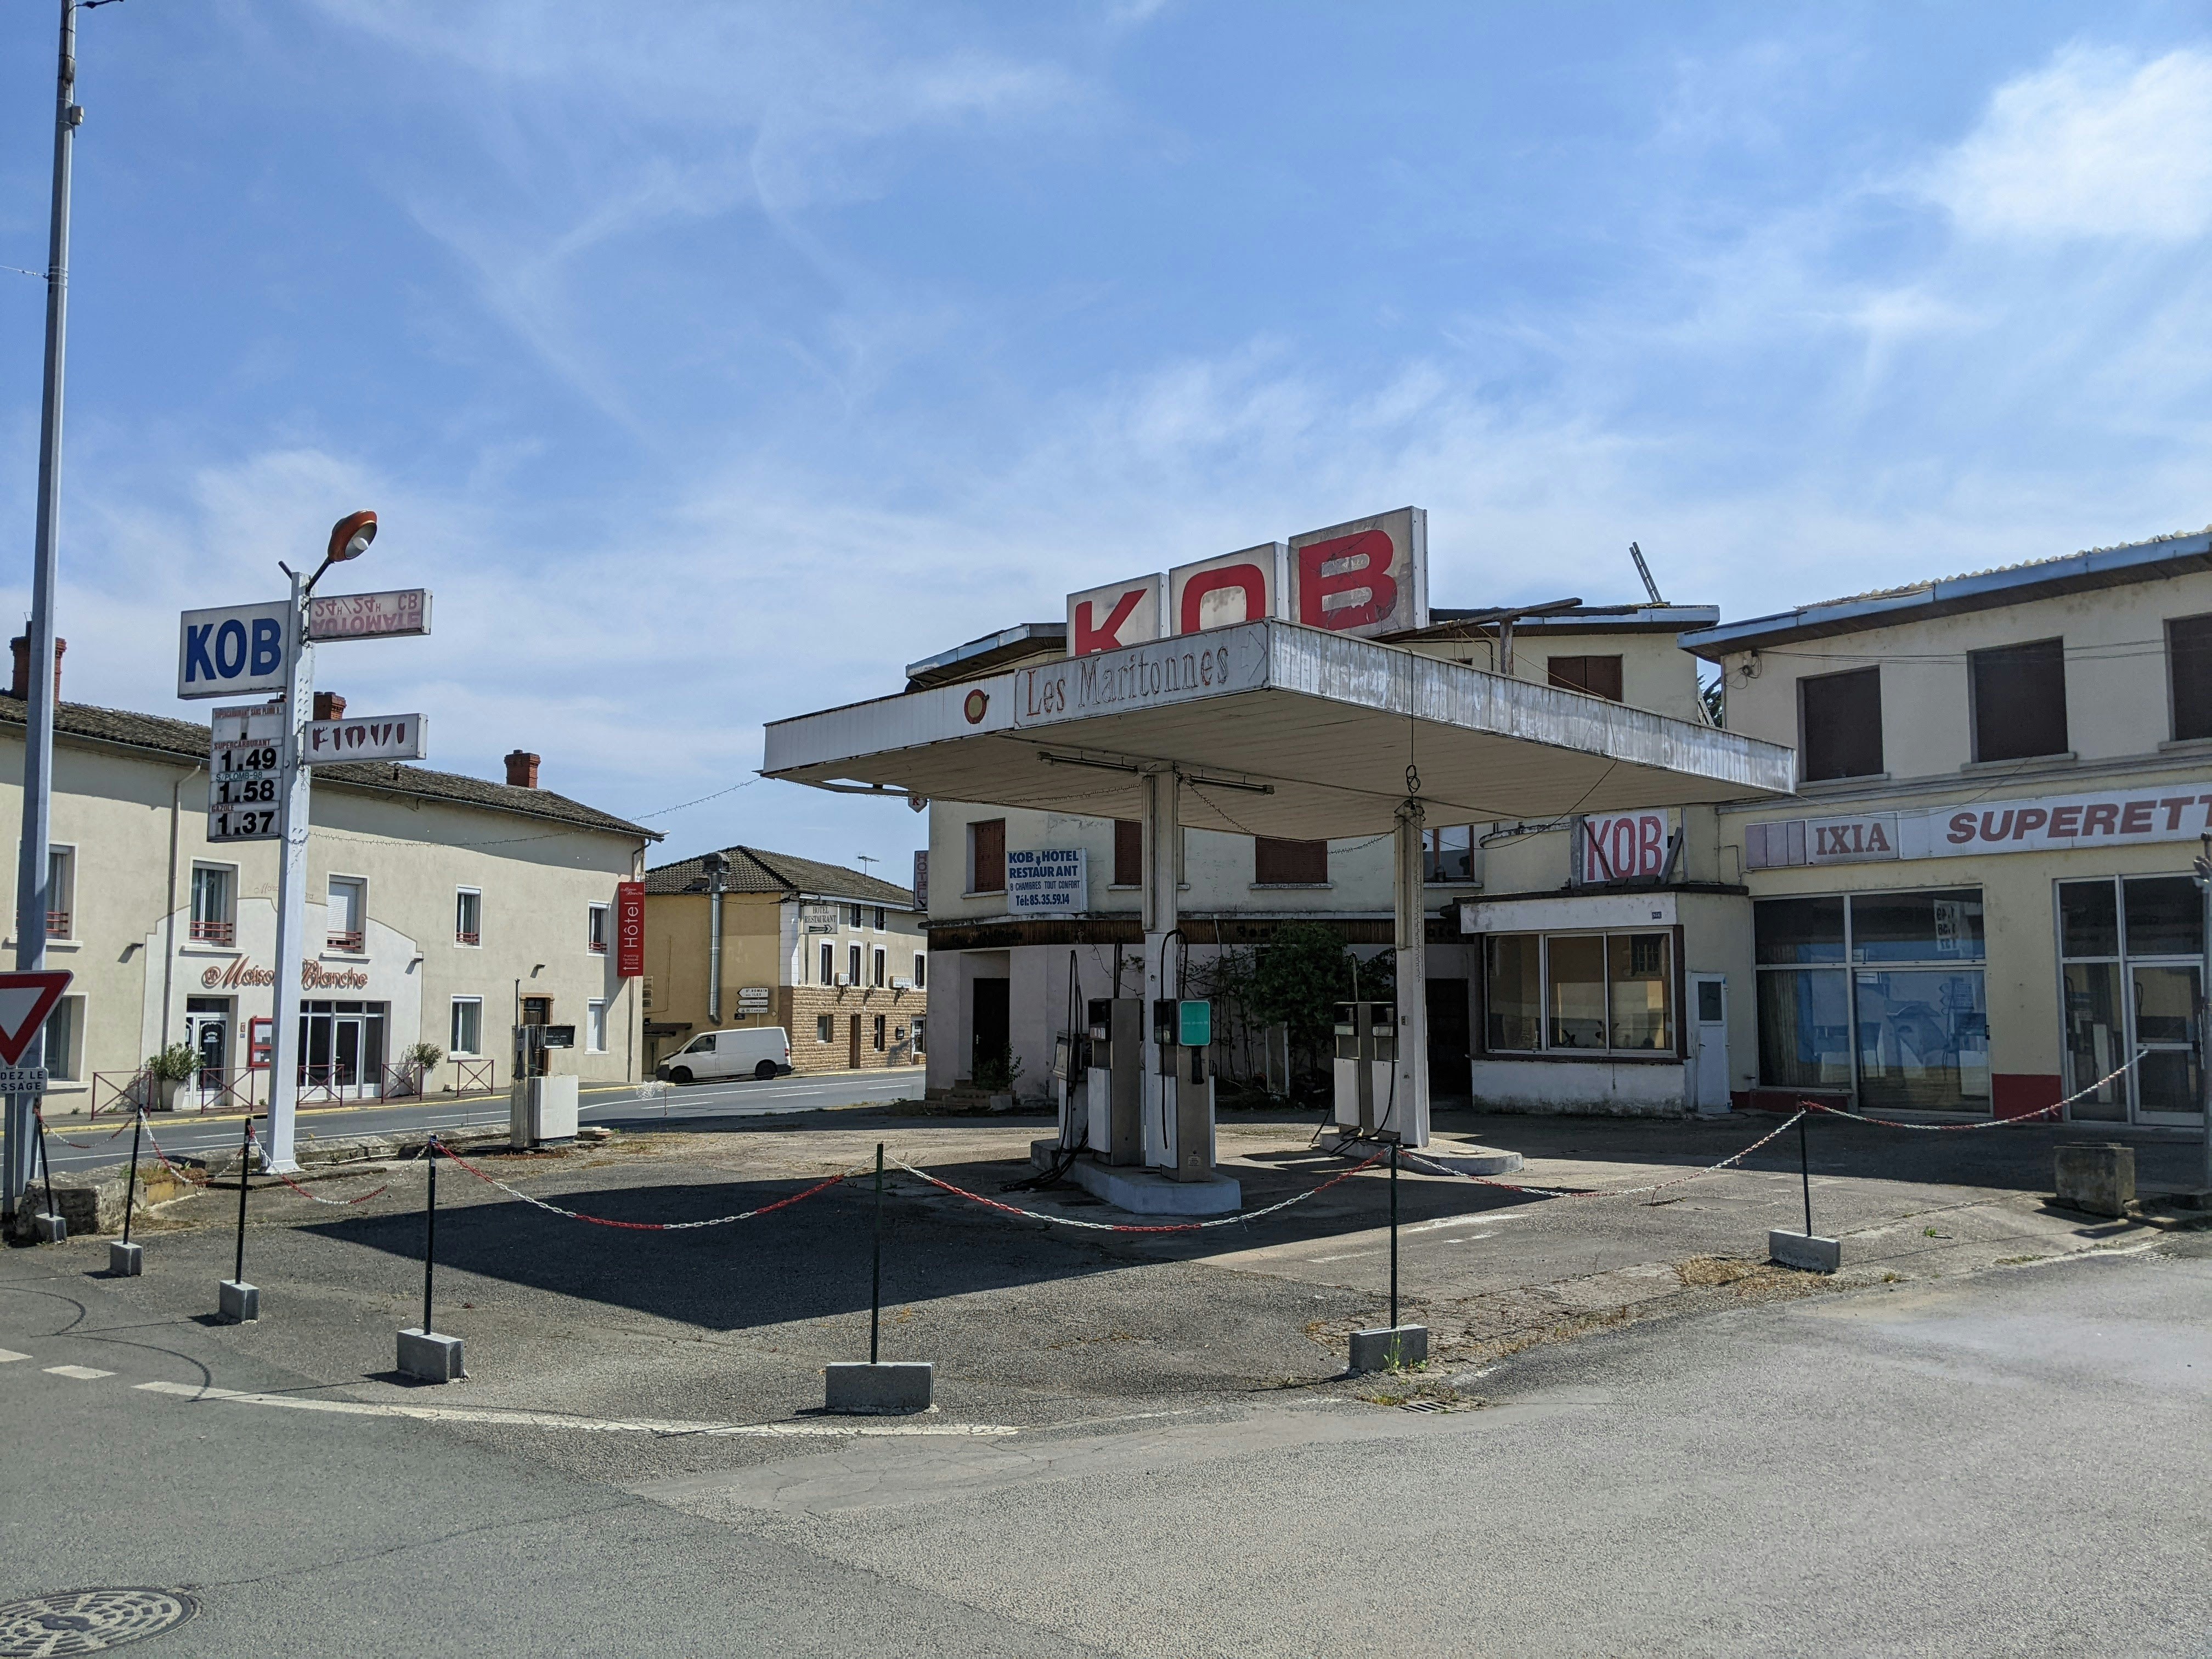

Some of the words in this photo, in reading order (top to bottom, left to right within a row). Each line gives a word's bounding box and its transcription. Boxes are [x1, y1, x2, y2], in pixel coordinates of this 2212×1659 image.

[1075, 529, 1397, 657] KOB
[185, 618, 281, 682] KOB
[1026, 669, 1065, 716] Les
[1078, 646, 1229, 708] Maritonnes
[214, 738, 270, 749] SUPERCARBURANT
[221, 748, 276, 771] 1.49
[216, 772, 262, 781] S/PLOMB-98
[219, 780, 274, 803] 1.58
[218, 811, 274, 834] 1.37
[1588, 816, 1662, 881] KOB
[1816, 823, 1891, 855] IXIA
[1009, 851, 1034, 864] KOB
[1042, 850, 1079, 862] HOTEL
[917, 853, 927, 900] HOTEL
[1009, 865, 1077, 878] RESTAURANT
[1010, 883, 1013, 891] 8
[1015, 881, 1041, 890] CHAMBRES
[1044, 881, 1057, 889] TOUT
[1058, 880, 1080, 888] CONFORT
[623, 902, 639, 947] Hôtel
[804, 915, 837, 923] RESTAURANT
[205, 953, 274, 986] Maiso
[302, 958, 368, 988] Blanche
[0, 1071, 24, 1080] DEZ
[30, 1071, 43, 1079] LE
[1, 1082, 41, 1091] SSAGE
